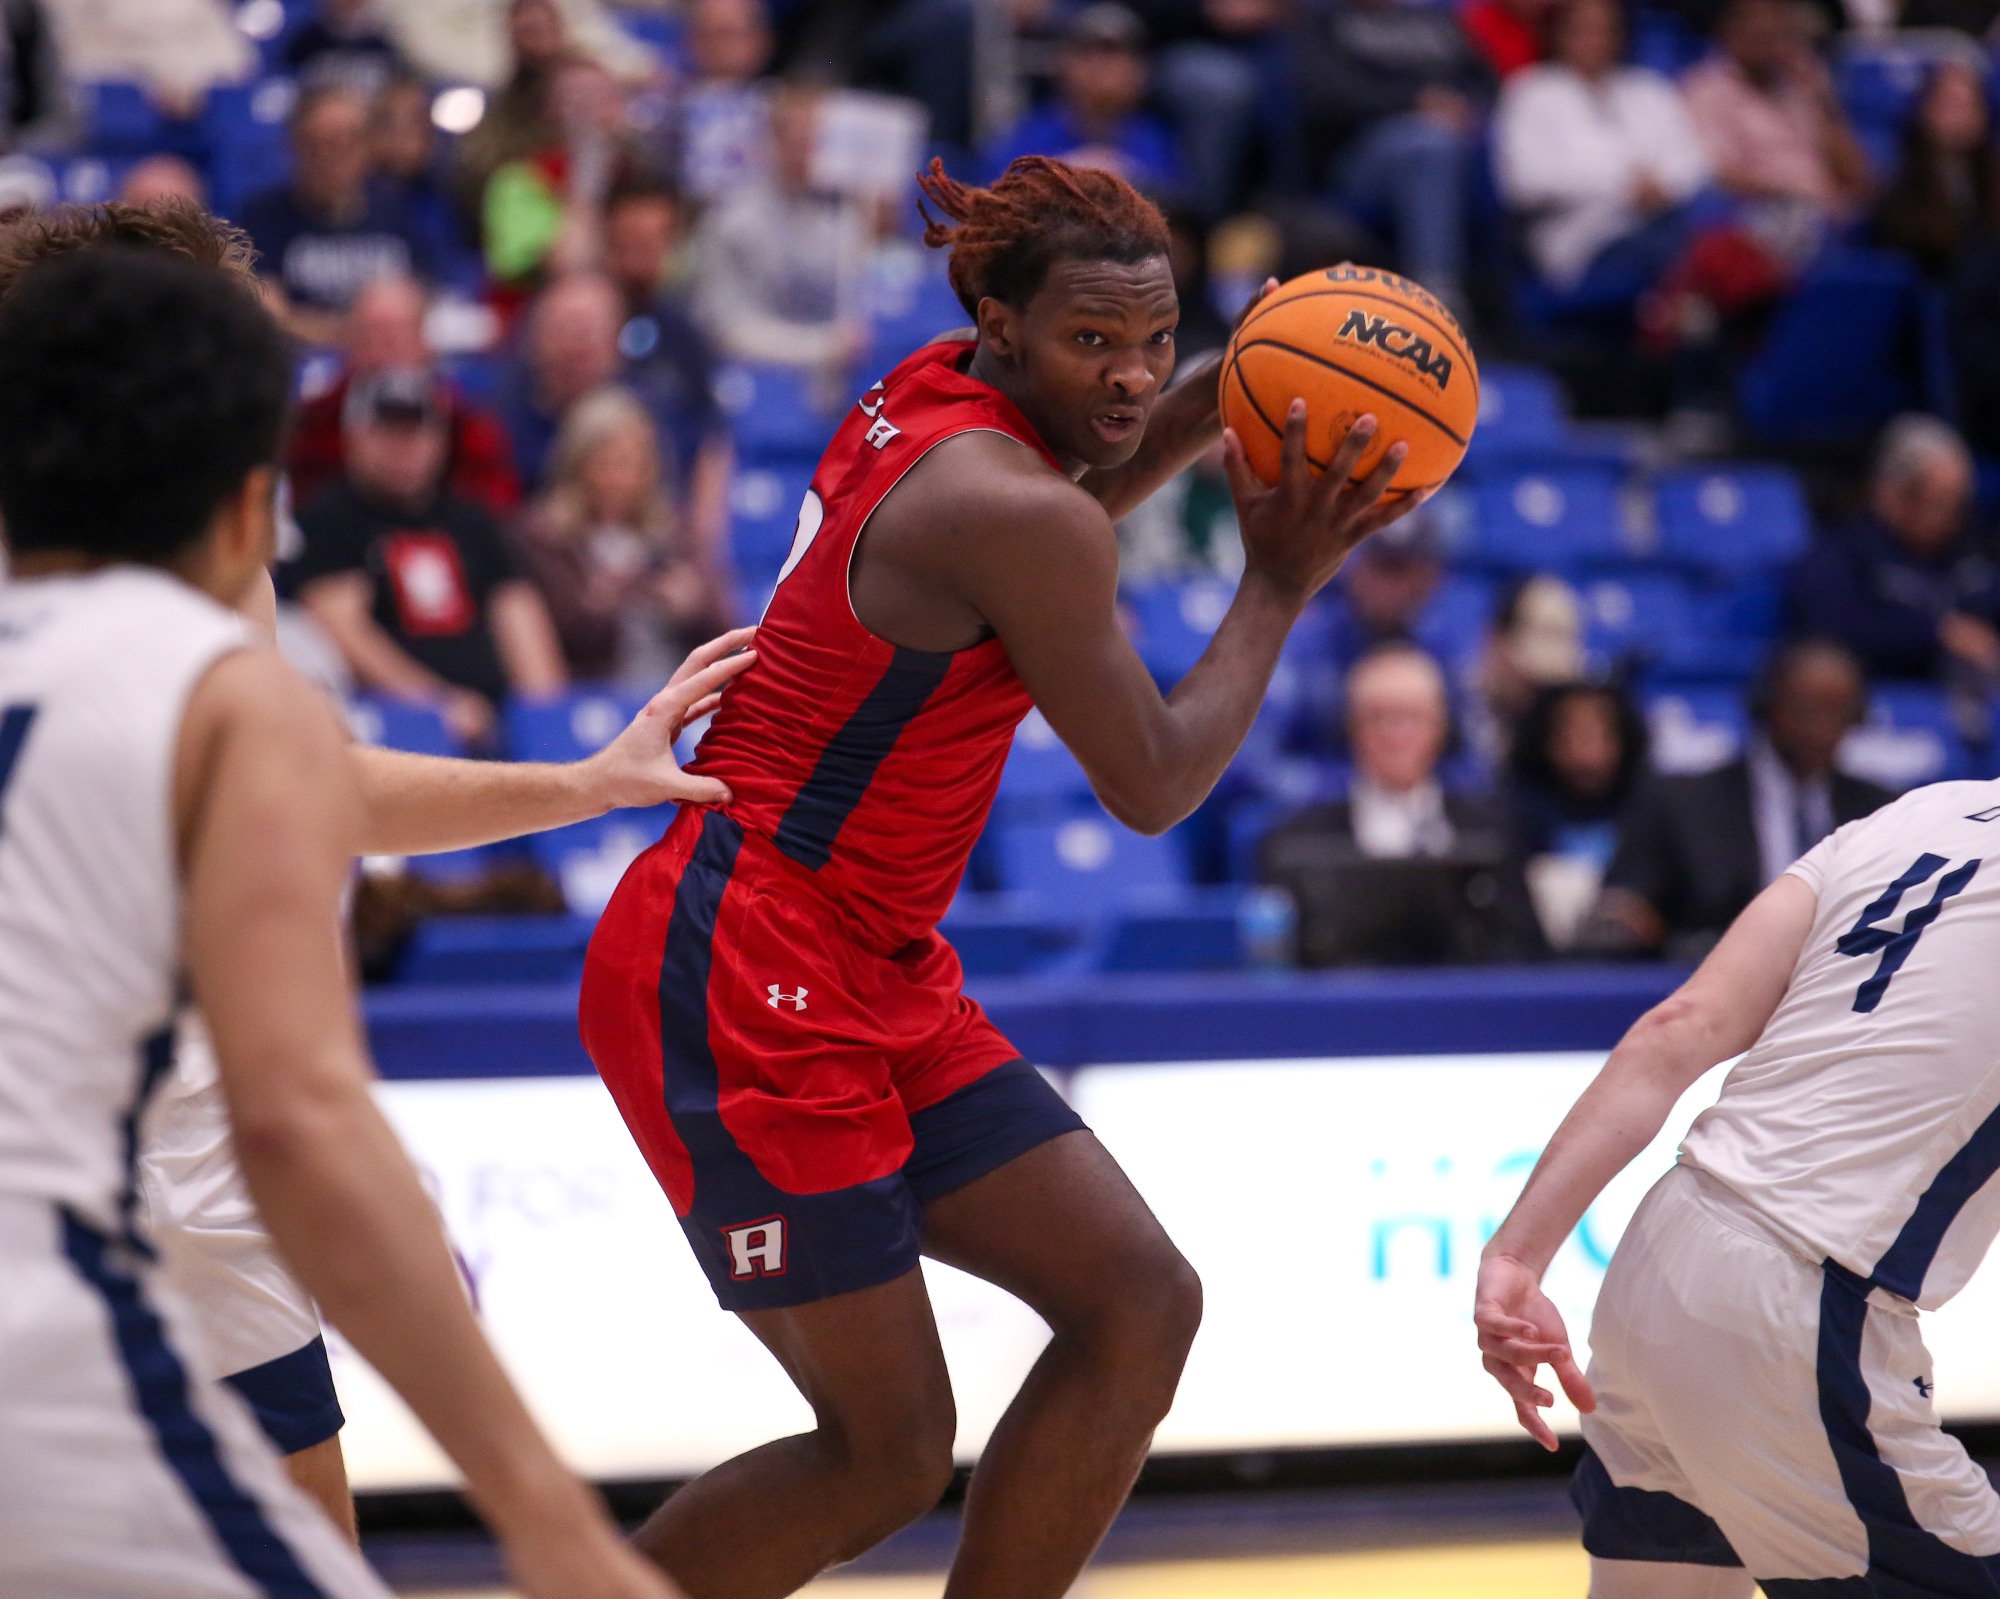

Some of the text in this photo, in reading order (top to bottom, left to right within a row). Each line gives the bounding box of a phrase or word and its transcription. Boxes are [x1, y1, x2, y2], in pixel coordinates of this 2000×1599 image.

[1333, 309, 1453, 391] NCAA
[1834, 853, 1982, 1013] 4
[719, 1213, 788, 1281] A
